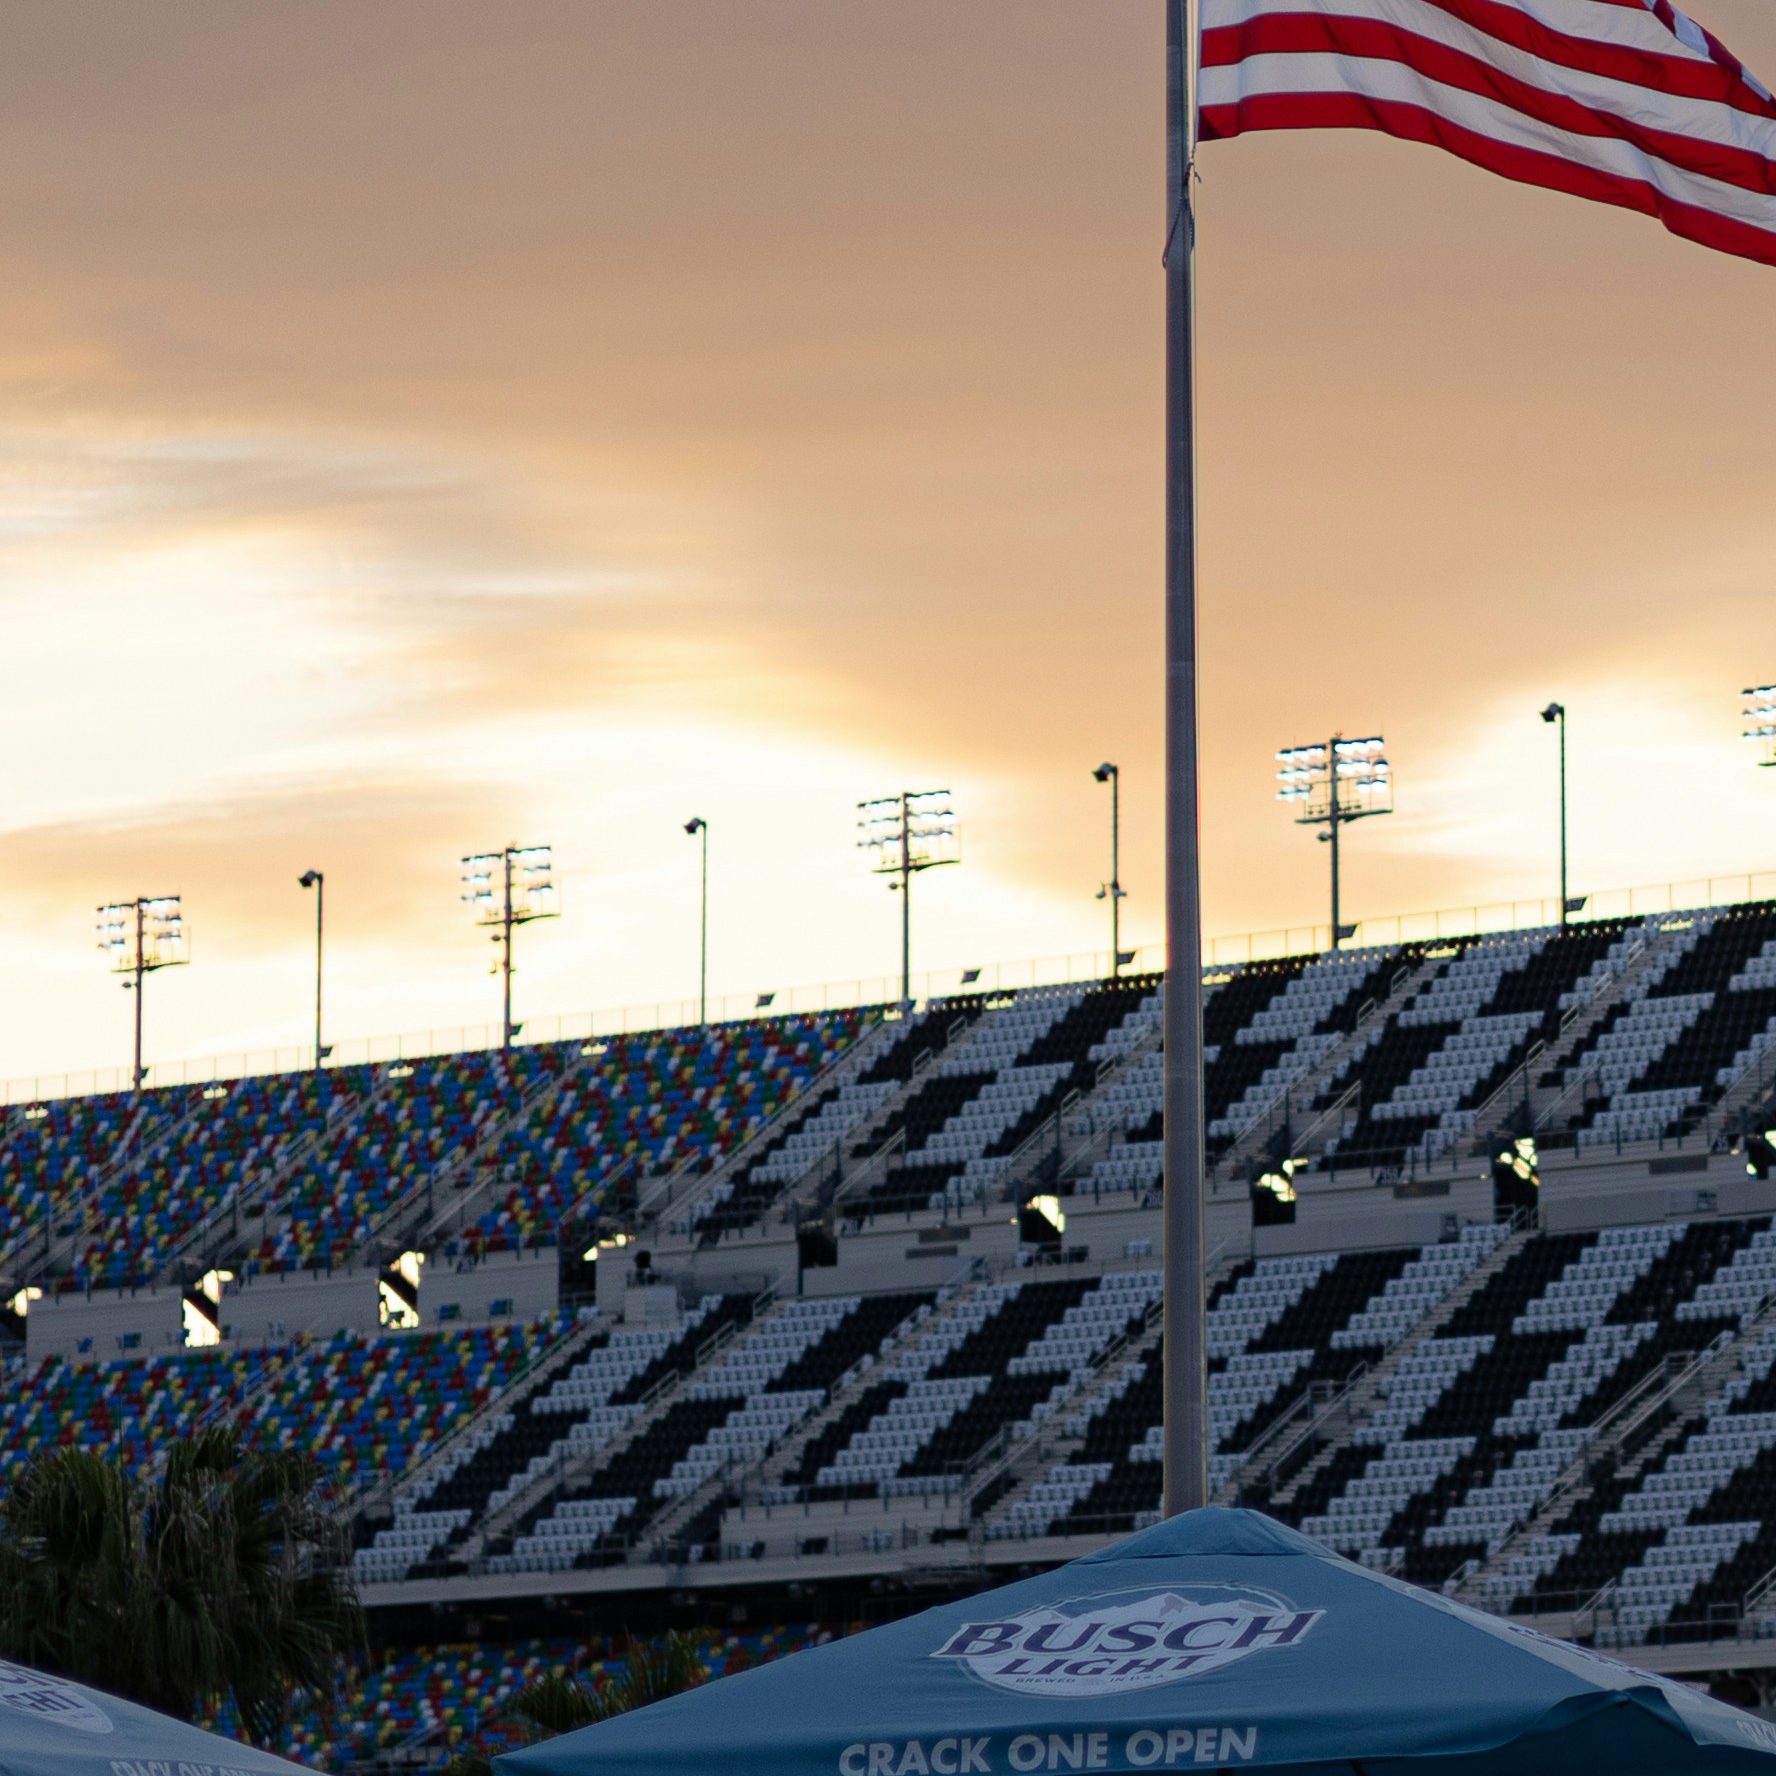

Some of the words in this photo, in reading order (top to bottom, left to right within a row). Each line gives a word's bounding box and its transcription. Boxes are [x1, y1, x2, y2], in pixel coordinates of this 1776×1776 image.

[941, 1612, 1315, 1657] BUSCH
[994, 1654, 1215, 1676] LIGHT
[1007, 1732, 1109, 1772] ONE
[1125, 1726, 1258, 1767] OPEN
